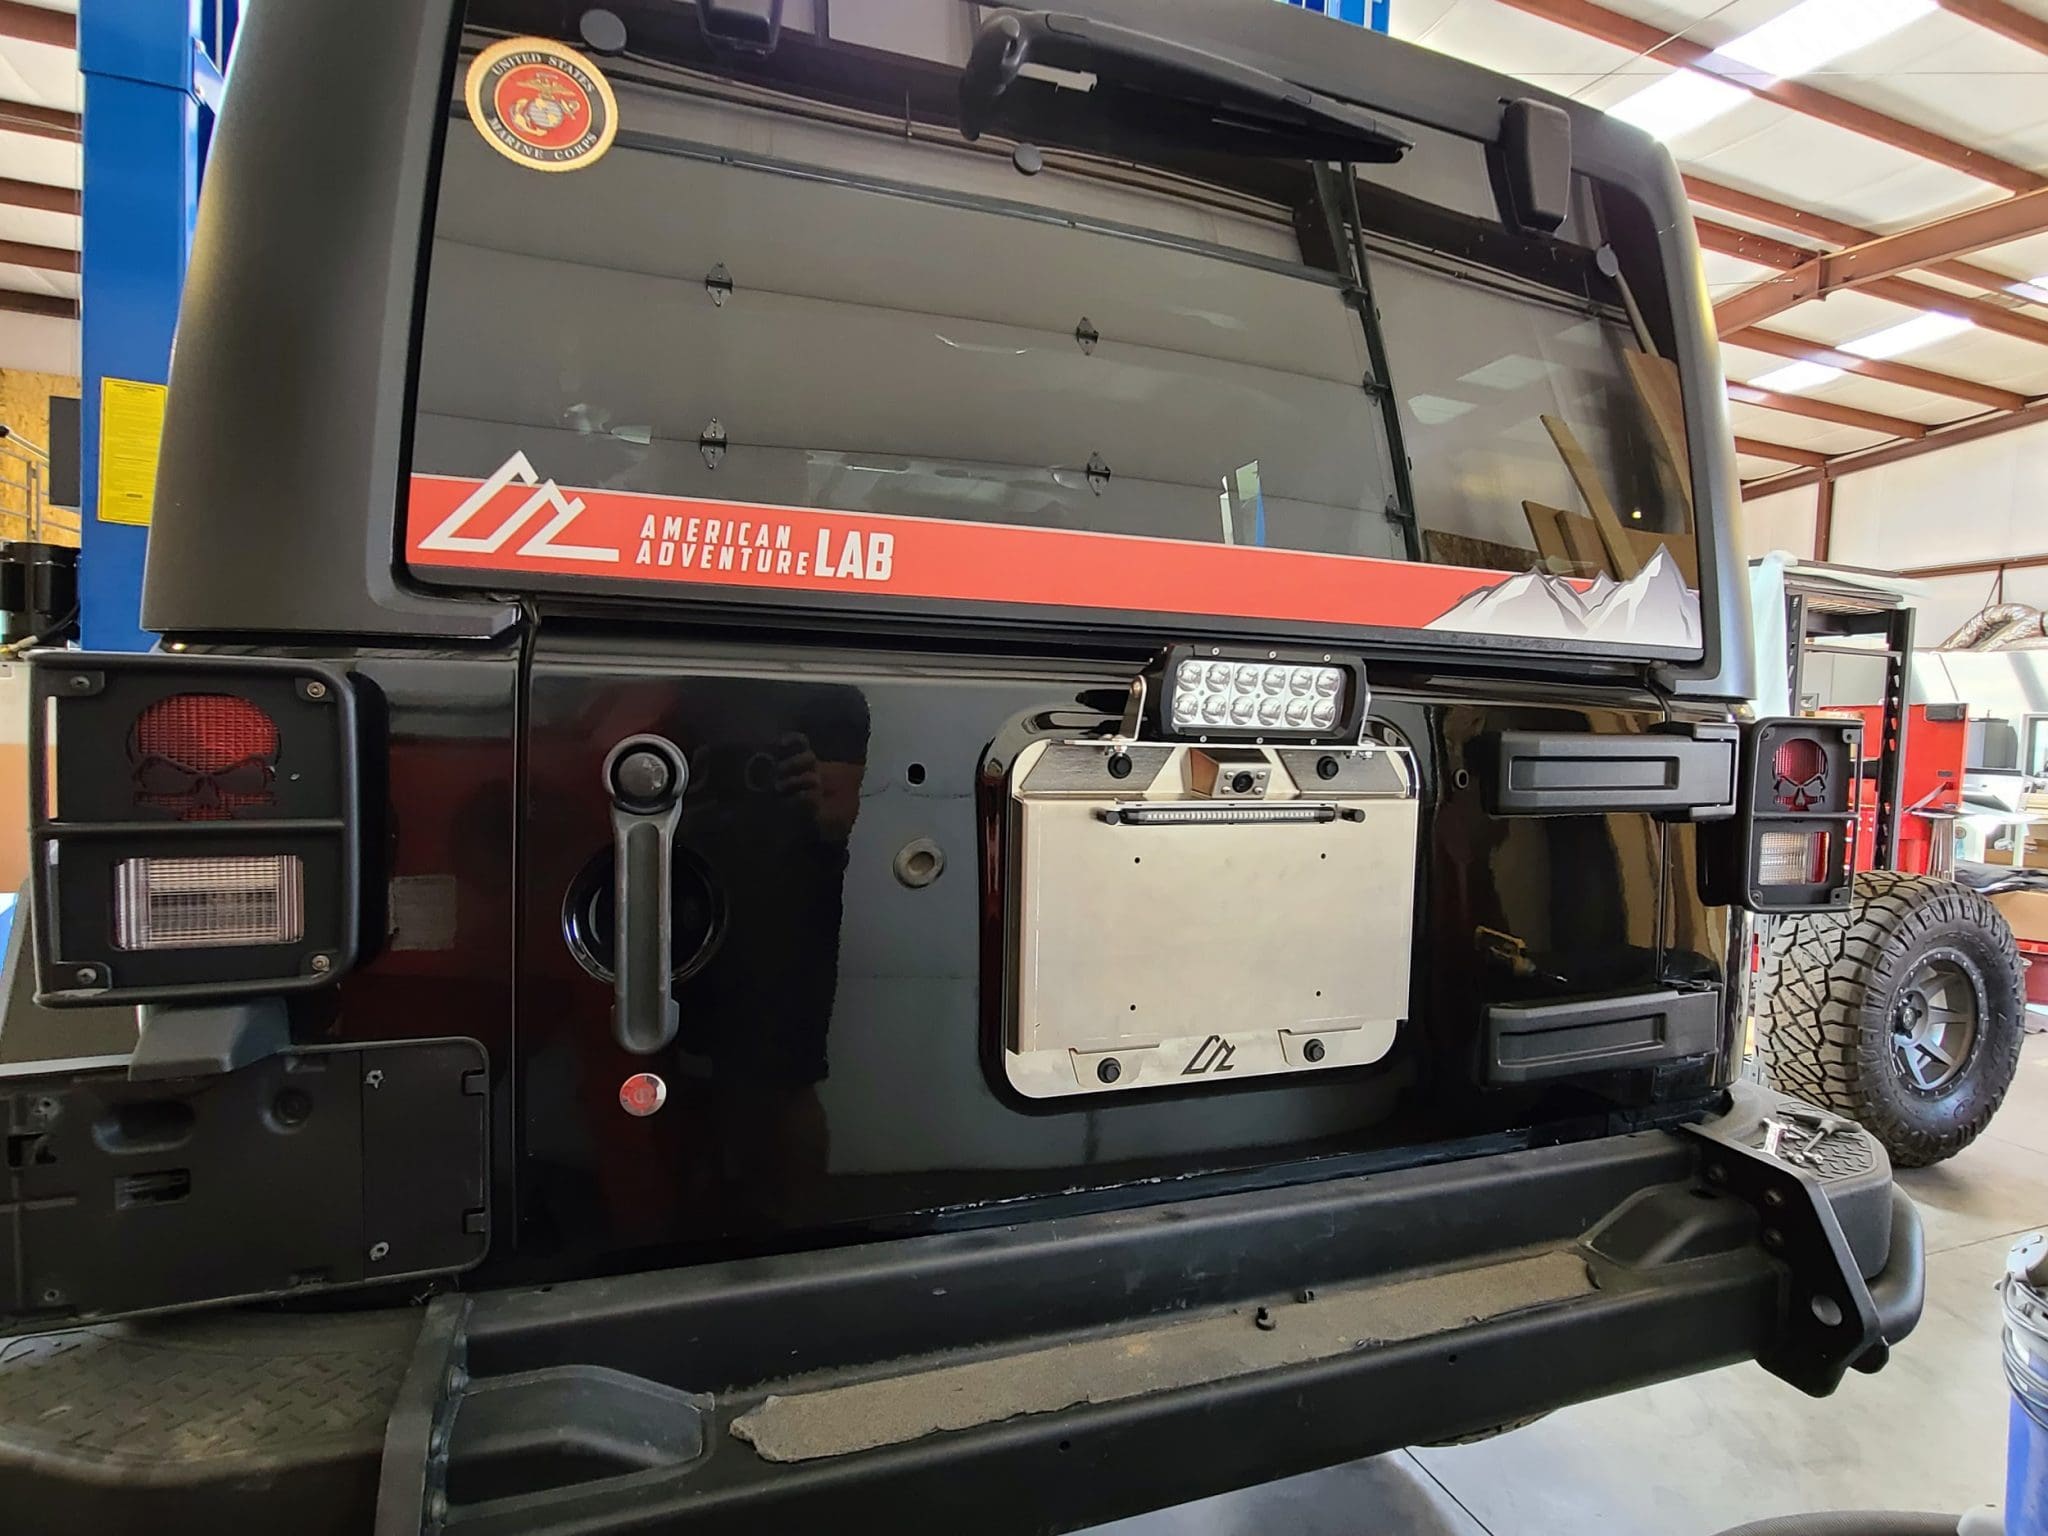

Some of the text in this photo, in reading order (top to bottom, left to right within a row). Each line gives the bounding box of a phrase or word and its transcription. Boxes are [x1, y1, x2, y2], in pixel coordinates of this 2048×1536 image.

[491, 53, 596, 93] UNITED STATES
[488, 116, 598, 161] MARINE CORPS
[640, 514, 792, 550] AMERICAN
[635, 528, 895, 582] ADVENTURE LAB
